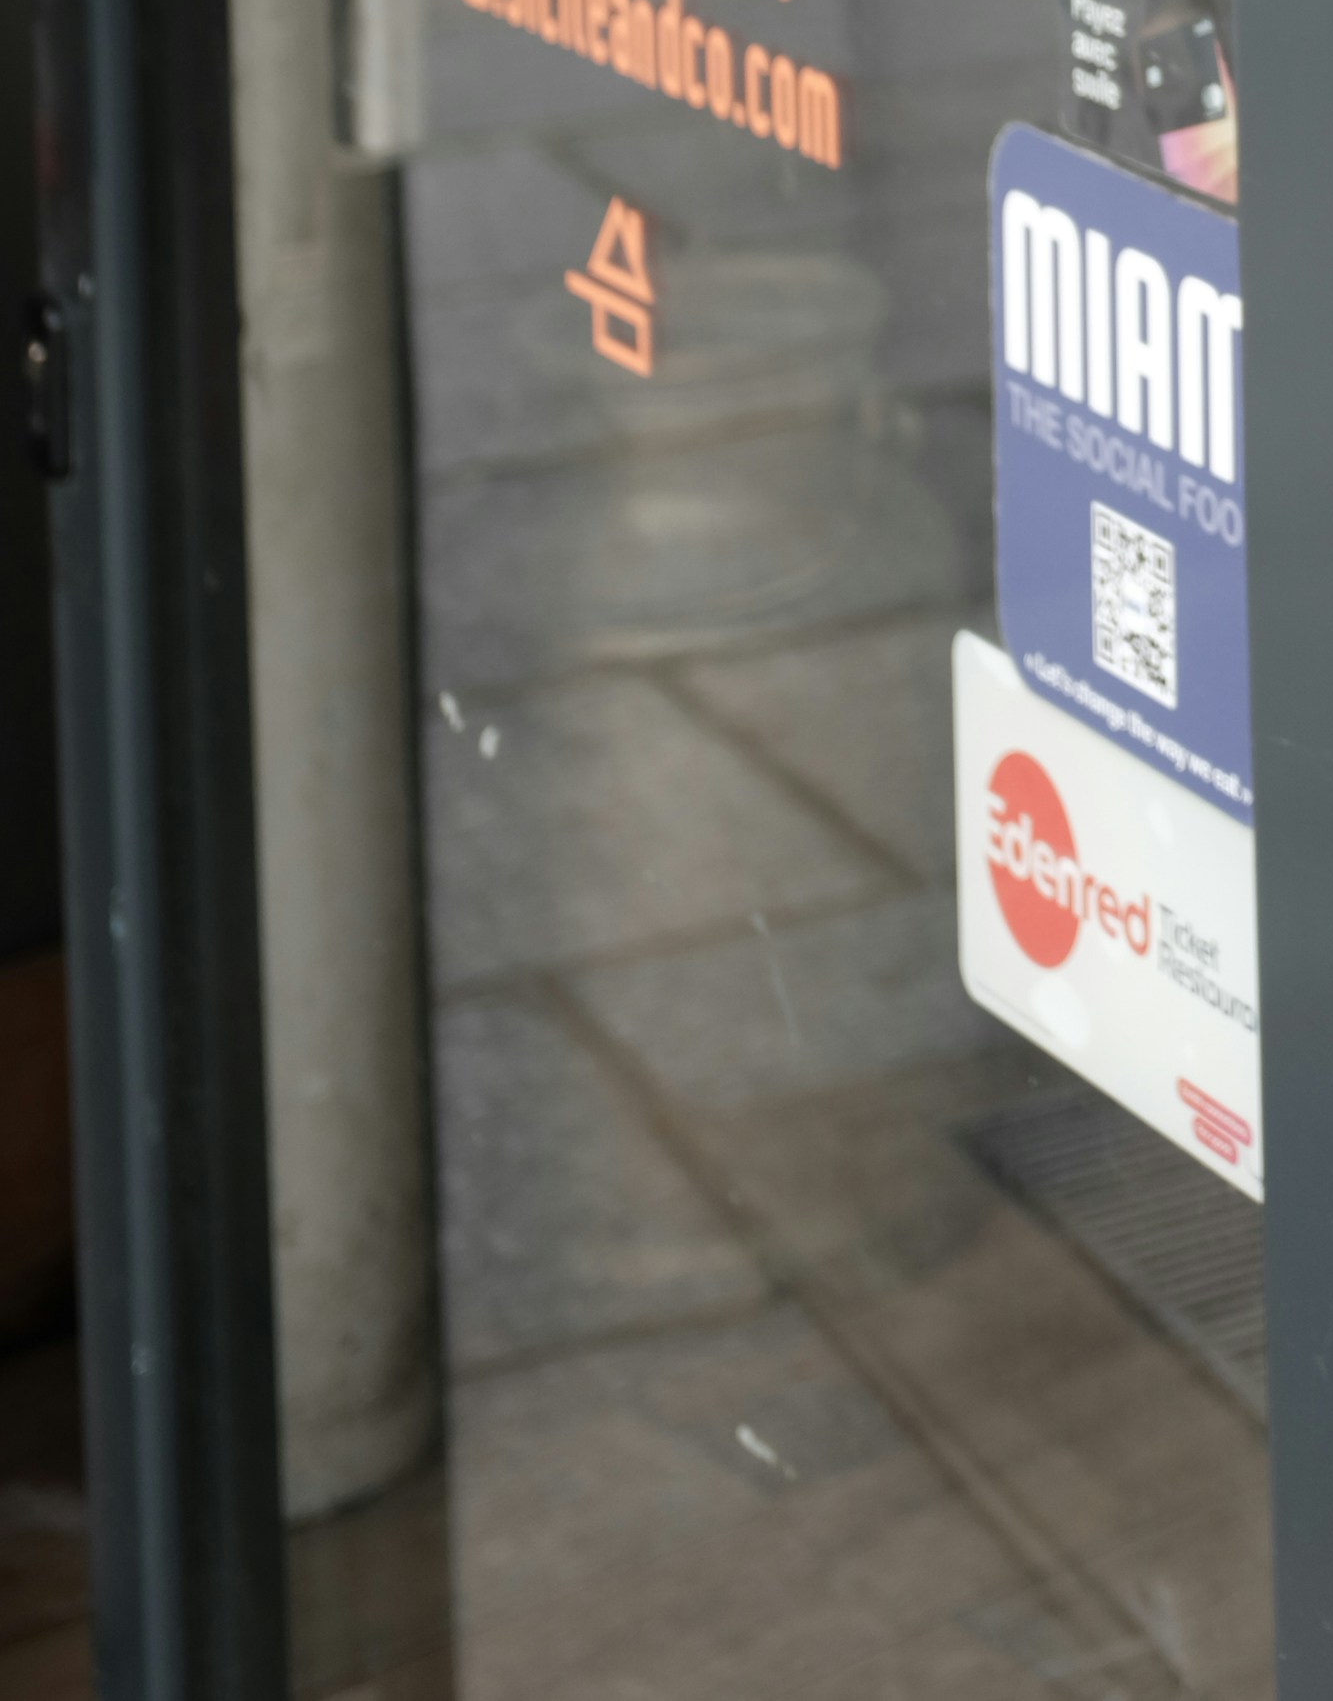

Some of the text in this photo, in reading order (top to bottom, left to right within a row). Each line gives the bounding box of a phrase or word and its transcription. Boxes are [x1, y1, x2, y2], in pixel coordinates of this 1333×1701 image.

[1006, 380, 1064, 452] THE
[1065, 415, 1175, 514] SOCIAL
[986, 788, 1152, 958] Edenred
